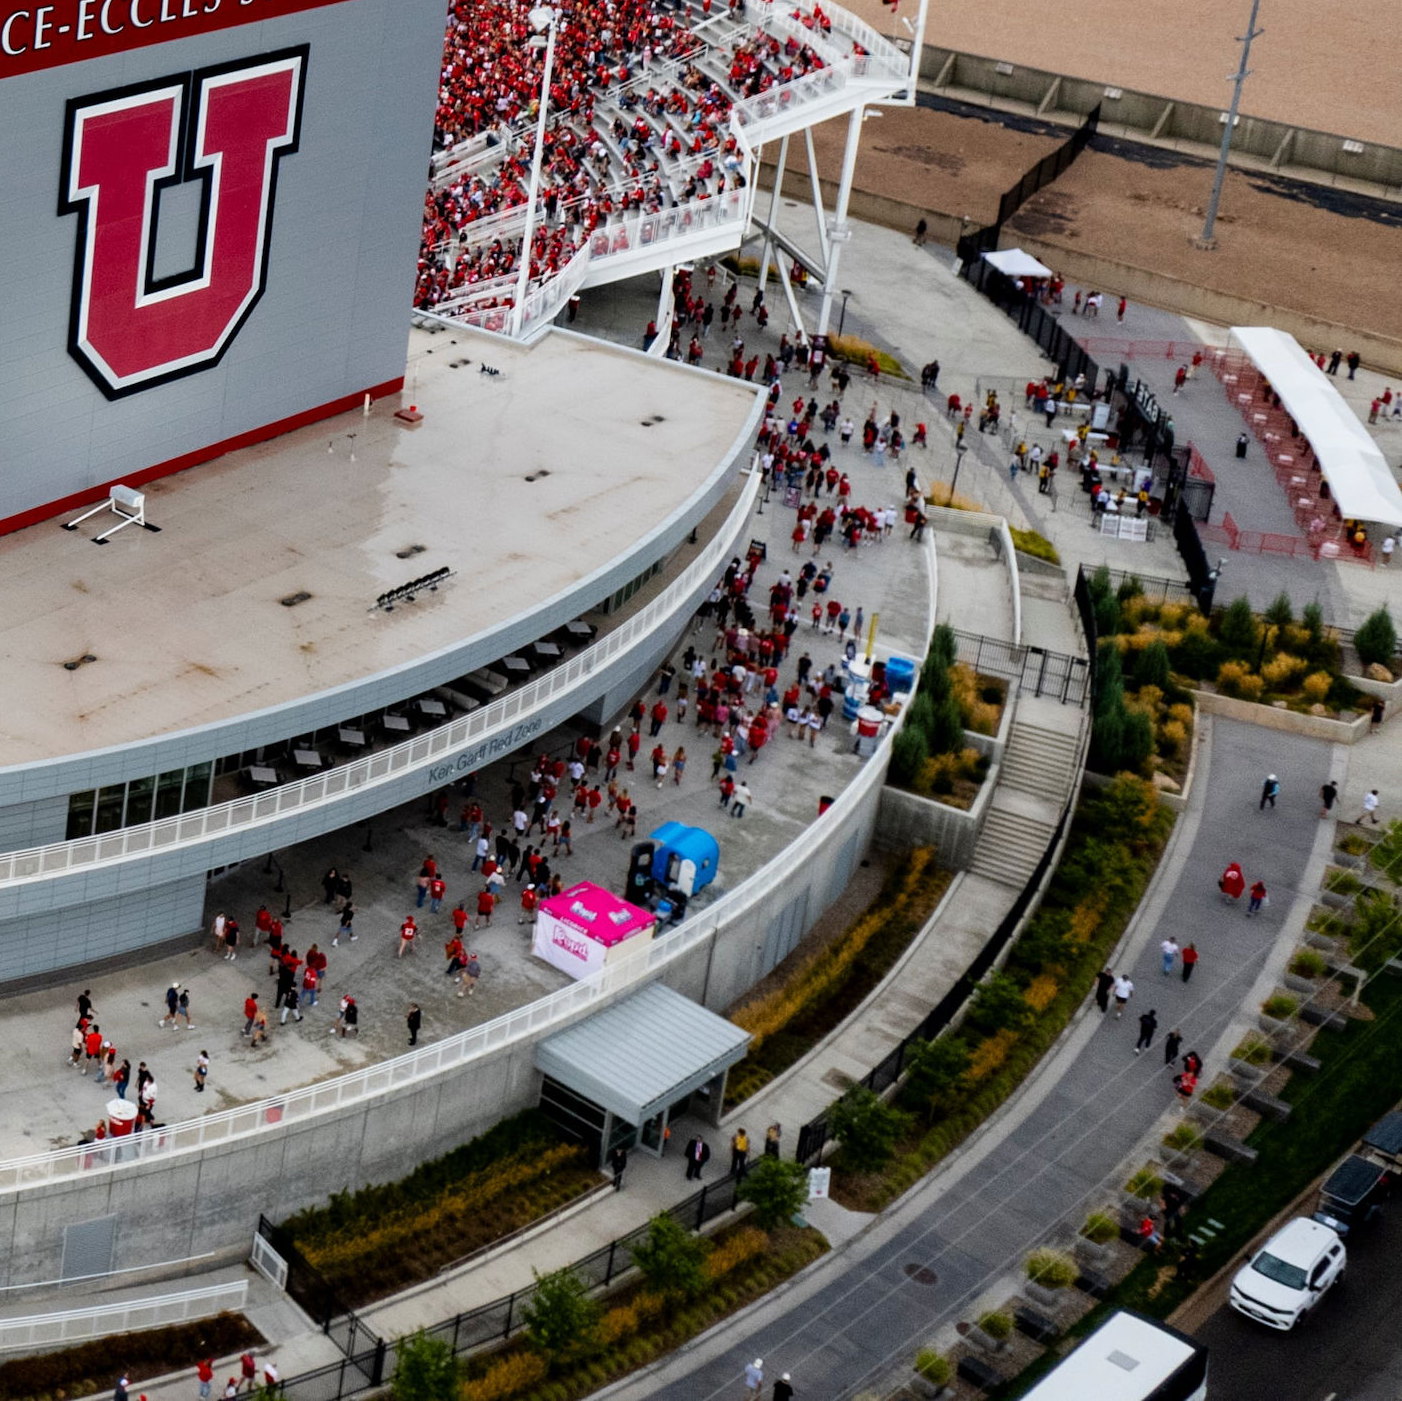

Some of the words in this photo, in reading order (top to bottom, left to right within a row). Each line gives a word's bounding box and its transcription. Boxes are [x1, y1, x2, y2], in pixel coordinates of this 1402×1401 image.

[57, 43, 310, 401] U
[429, 766, 454, 784] Ken
[457, 745, 488, 770] Garff
[489, 733, 513, 756] Red
[515, 719, 543, 742] Zone
